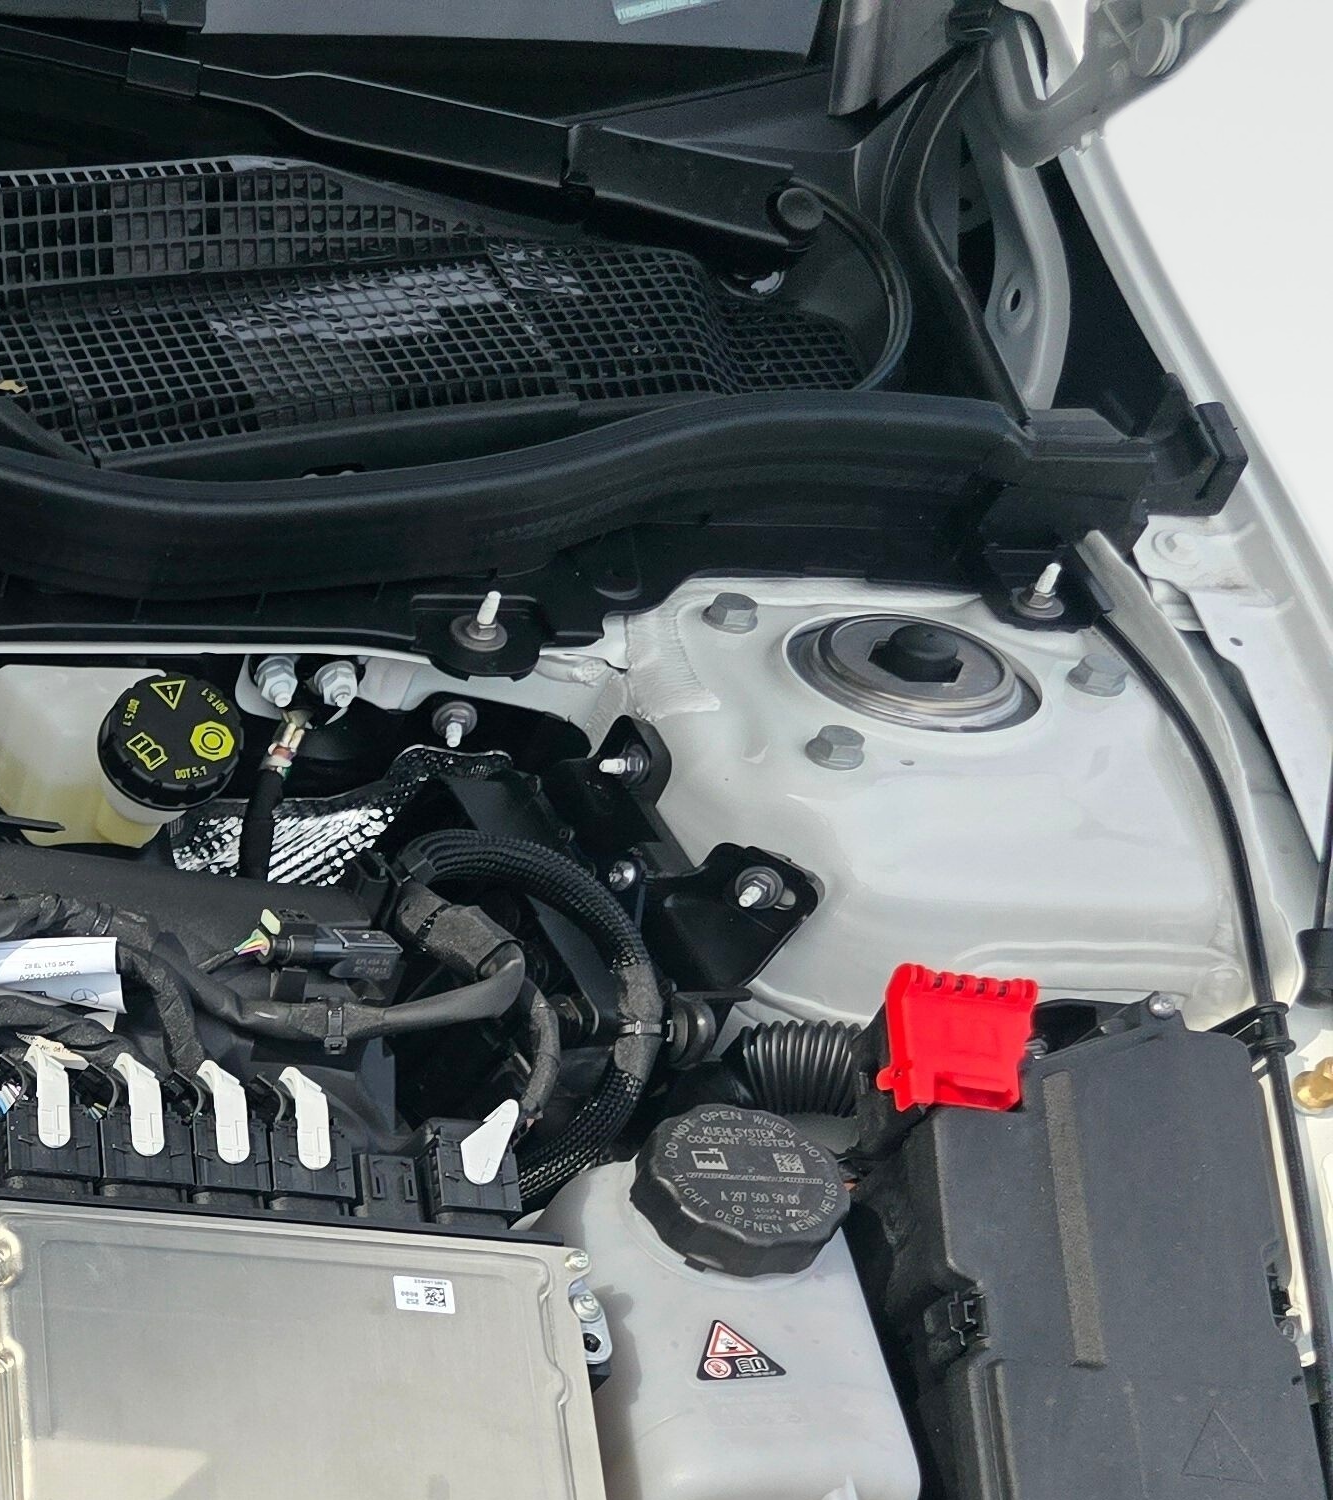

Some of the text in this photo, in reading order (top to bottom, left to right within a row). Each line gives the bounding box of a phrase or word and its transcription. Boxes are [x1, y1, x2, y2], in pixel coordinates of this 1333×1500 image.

[126, 698, 140, 713] DOT
[200, 688, 229, 715] DOT 5.1
[174, 765, 208, 780] DOT 5.1
[664, 1110, 830, 1166] DO NOT OPEN WHEN HOT
[685, 1134, 796, 1149] COOLANT SYSTEM
[672, 1173, 710, 1209] NICHT
[714, 1209, 783, 1235] OEFFNEN
[787, 1213, 823, 1233] WENN
[818, 1181, 839, 1216] HEISS
[729, 1191, 748, 1203] 297
[750, 1192, 770, 1204] 500
